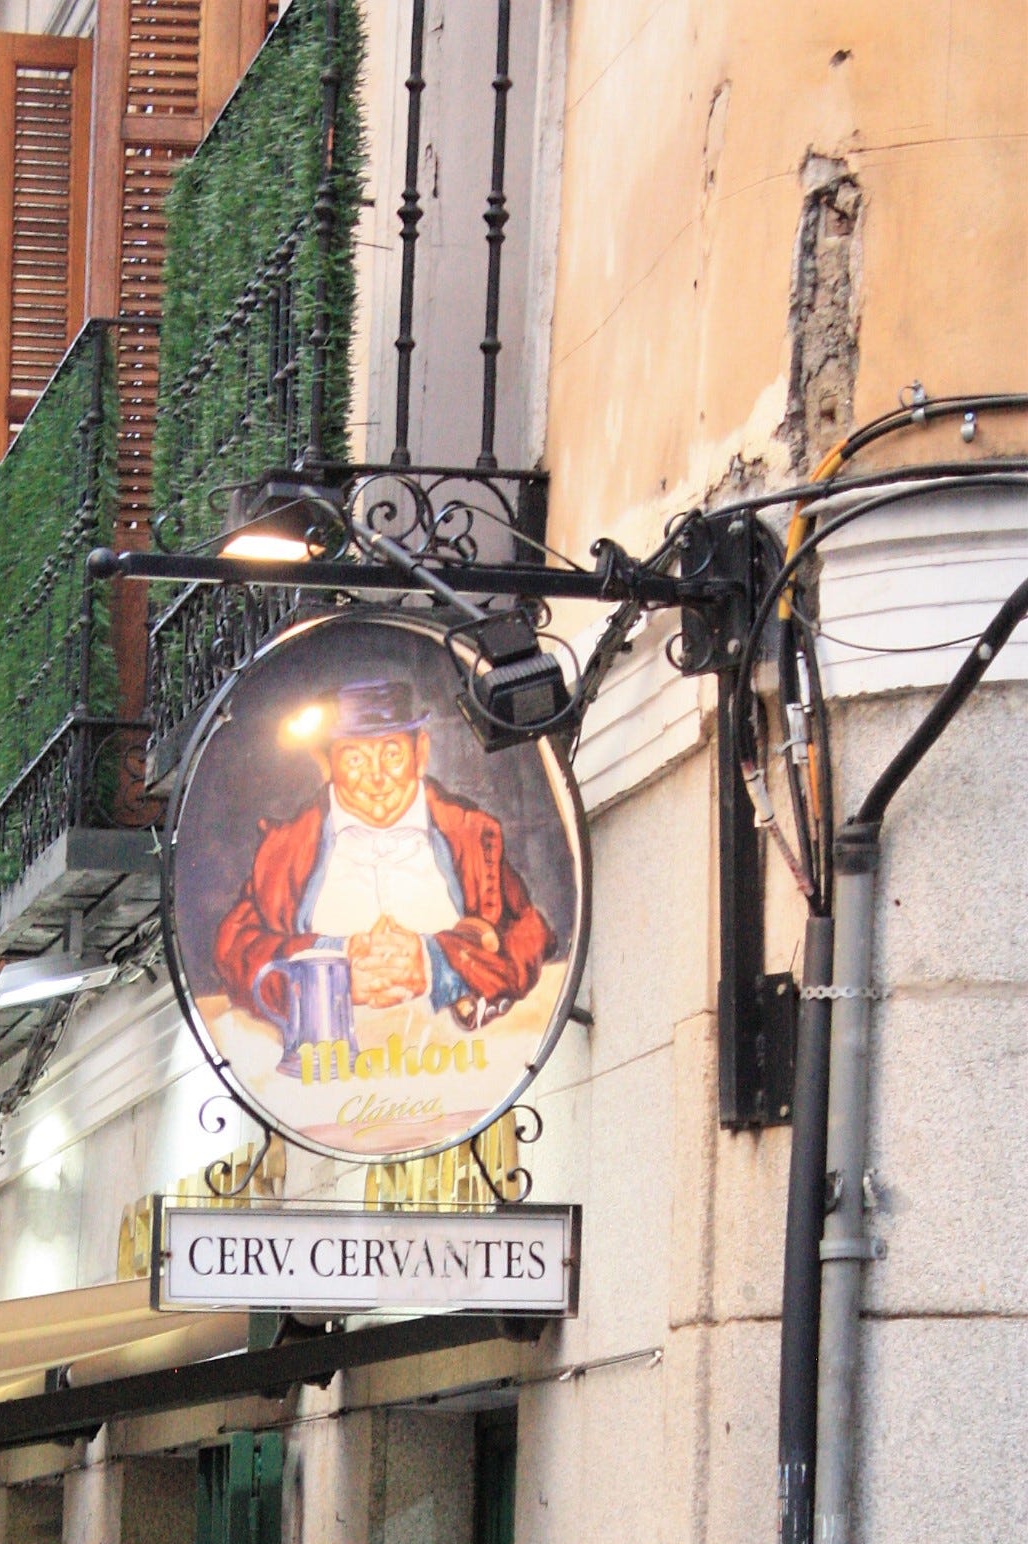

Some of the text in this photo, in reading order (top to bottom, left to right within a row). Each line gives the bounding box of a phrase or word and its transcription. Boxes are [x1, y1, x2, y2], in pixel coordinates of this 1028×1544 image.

[297, 1033, 489, 1086] Mahou
[188, 1236, 294, 1277] CERV.
[310, 1238, 547, 1280] CERVANTES
